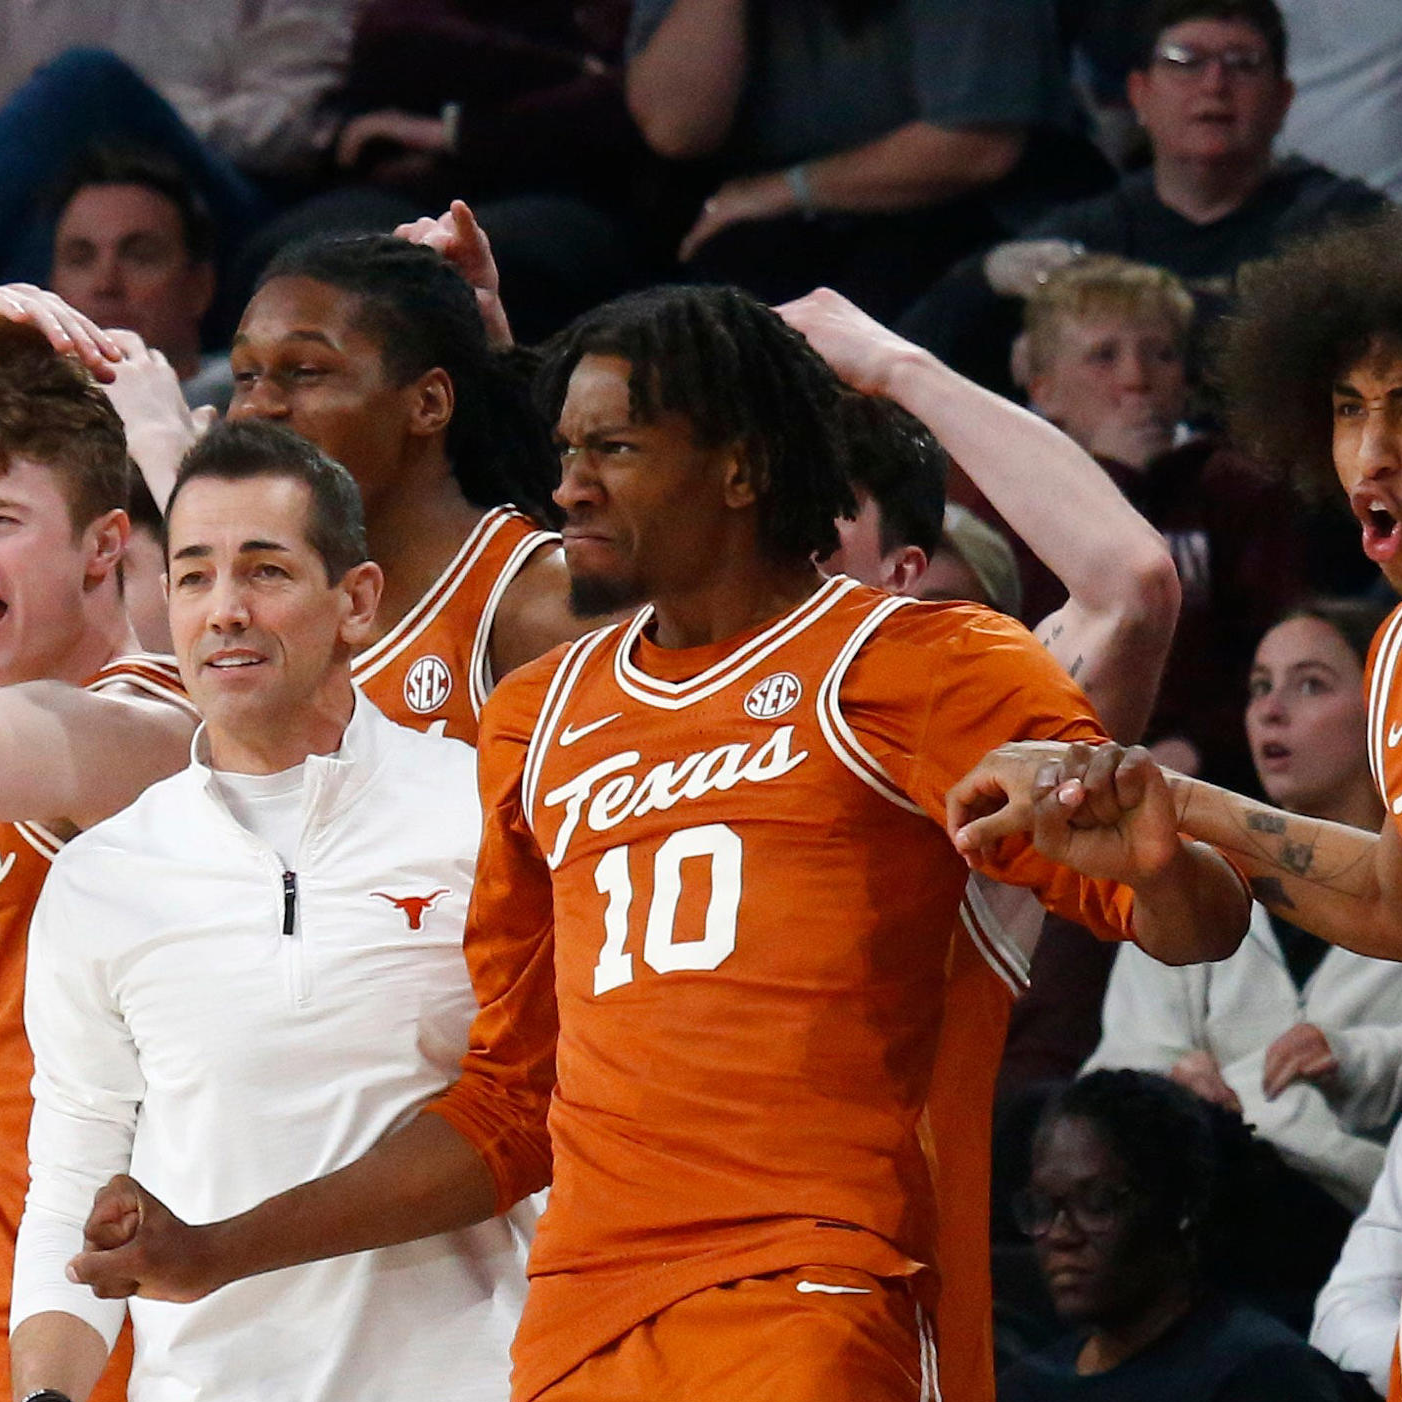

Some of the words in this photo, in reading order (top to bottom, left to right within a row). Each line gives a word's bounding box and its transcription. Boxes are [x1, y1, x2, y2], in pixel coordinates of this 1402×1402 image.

[406, 658, 448, 711] SEC
[746, 675, 800, 717] SEC
[544, 725, 809, 871] Texas
[593, 822, 743, 997] 10
